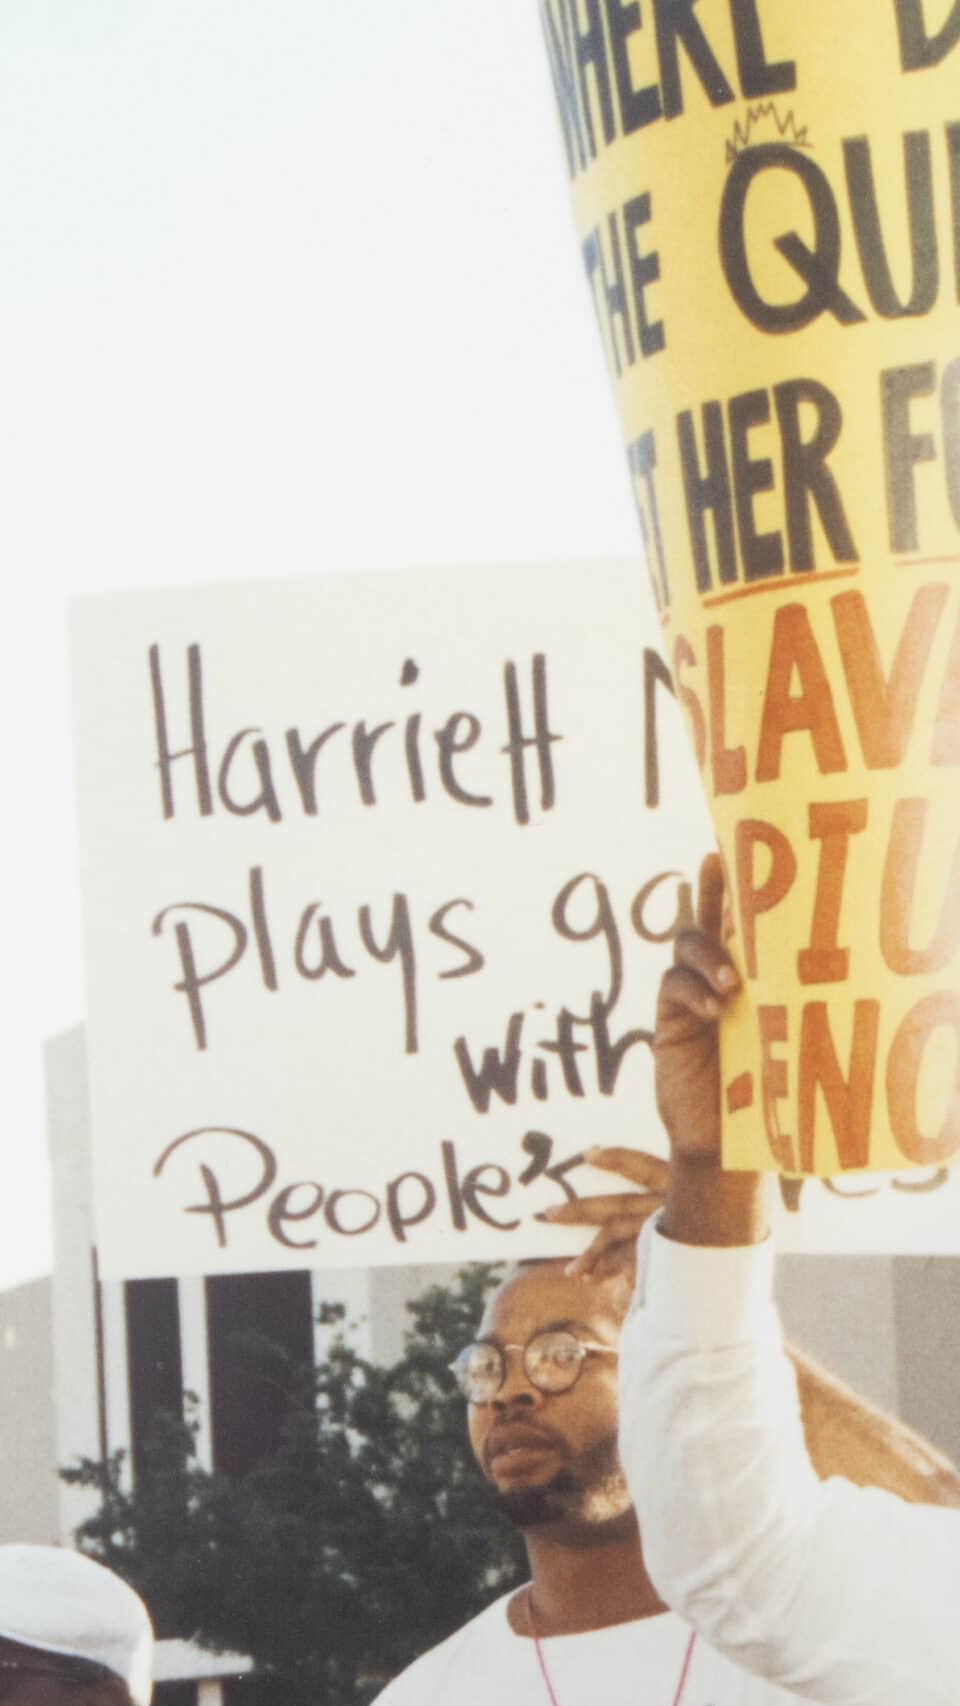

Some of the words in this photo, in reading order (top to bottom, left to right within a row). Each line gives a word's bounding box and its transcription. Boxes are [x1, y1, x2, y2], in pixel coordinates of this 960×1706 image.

[583, 191, 666, 378] THE
[676, 378, 860, 596] HER
[152, 866, 485, 1054] plays
[551, 871, 697, 1022] ga
